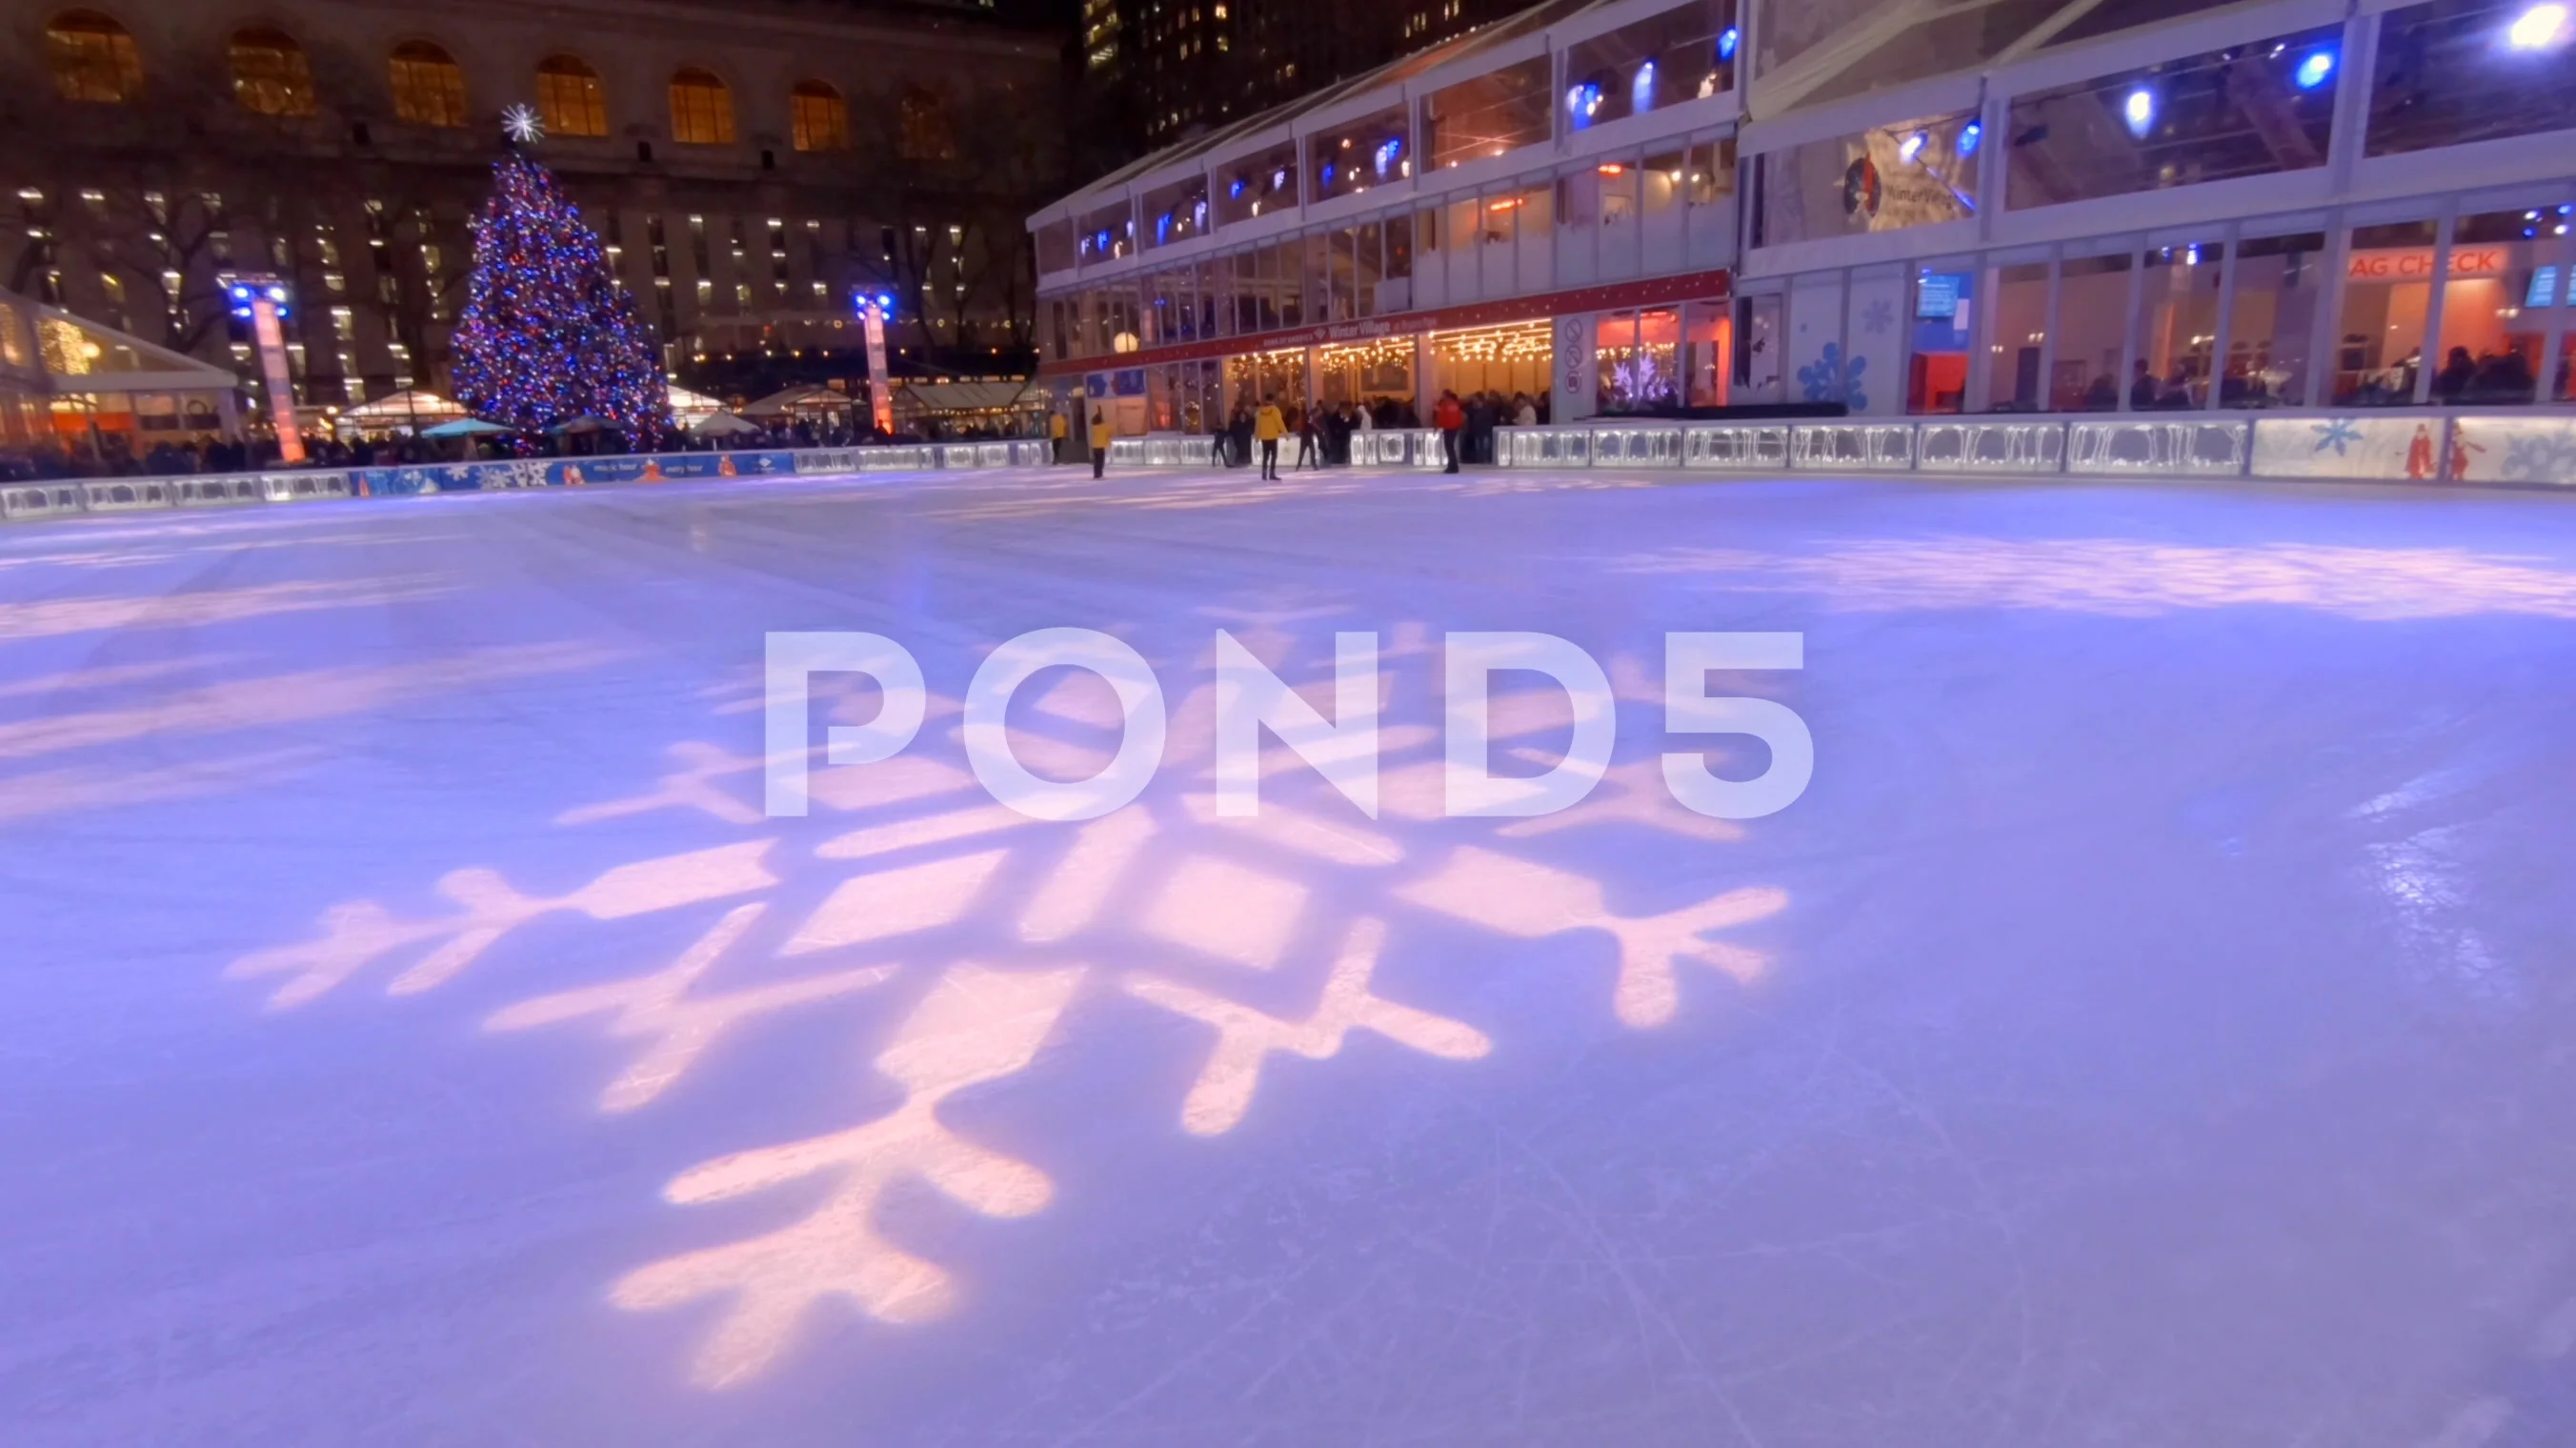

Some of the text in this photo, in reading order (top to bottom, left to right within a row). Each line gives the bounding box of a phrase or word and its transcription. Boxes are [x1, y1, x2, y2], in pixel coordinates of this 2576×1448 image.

[2349, 256, 2388, 278] AG
[1328, 325, 1358, 339] Winter
[1358, 319, 1391, 336] Village
